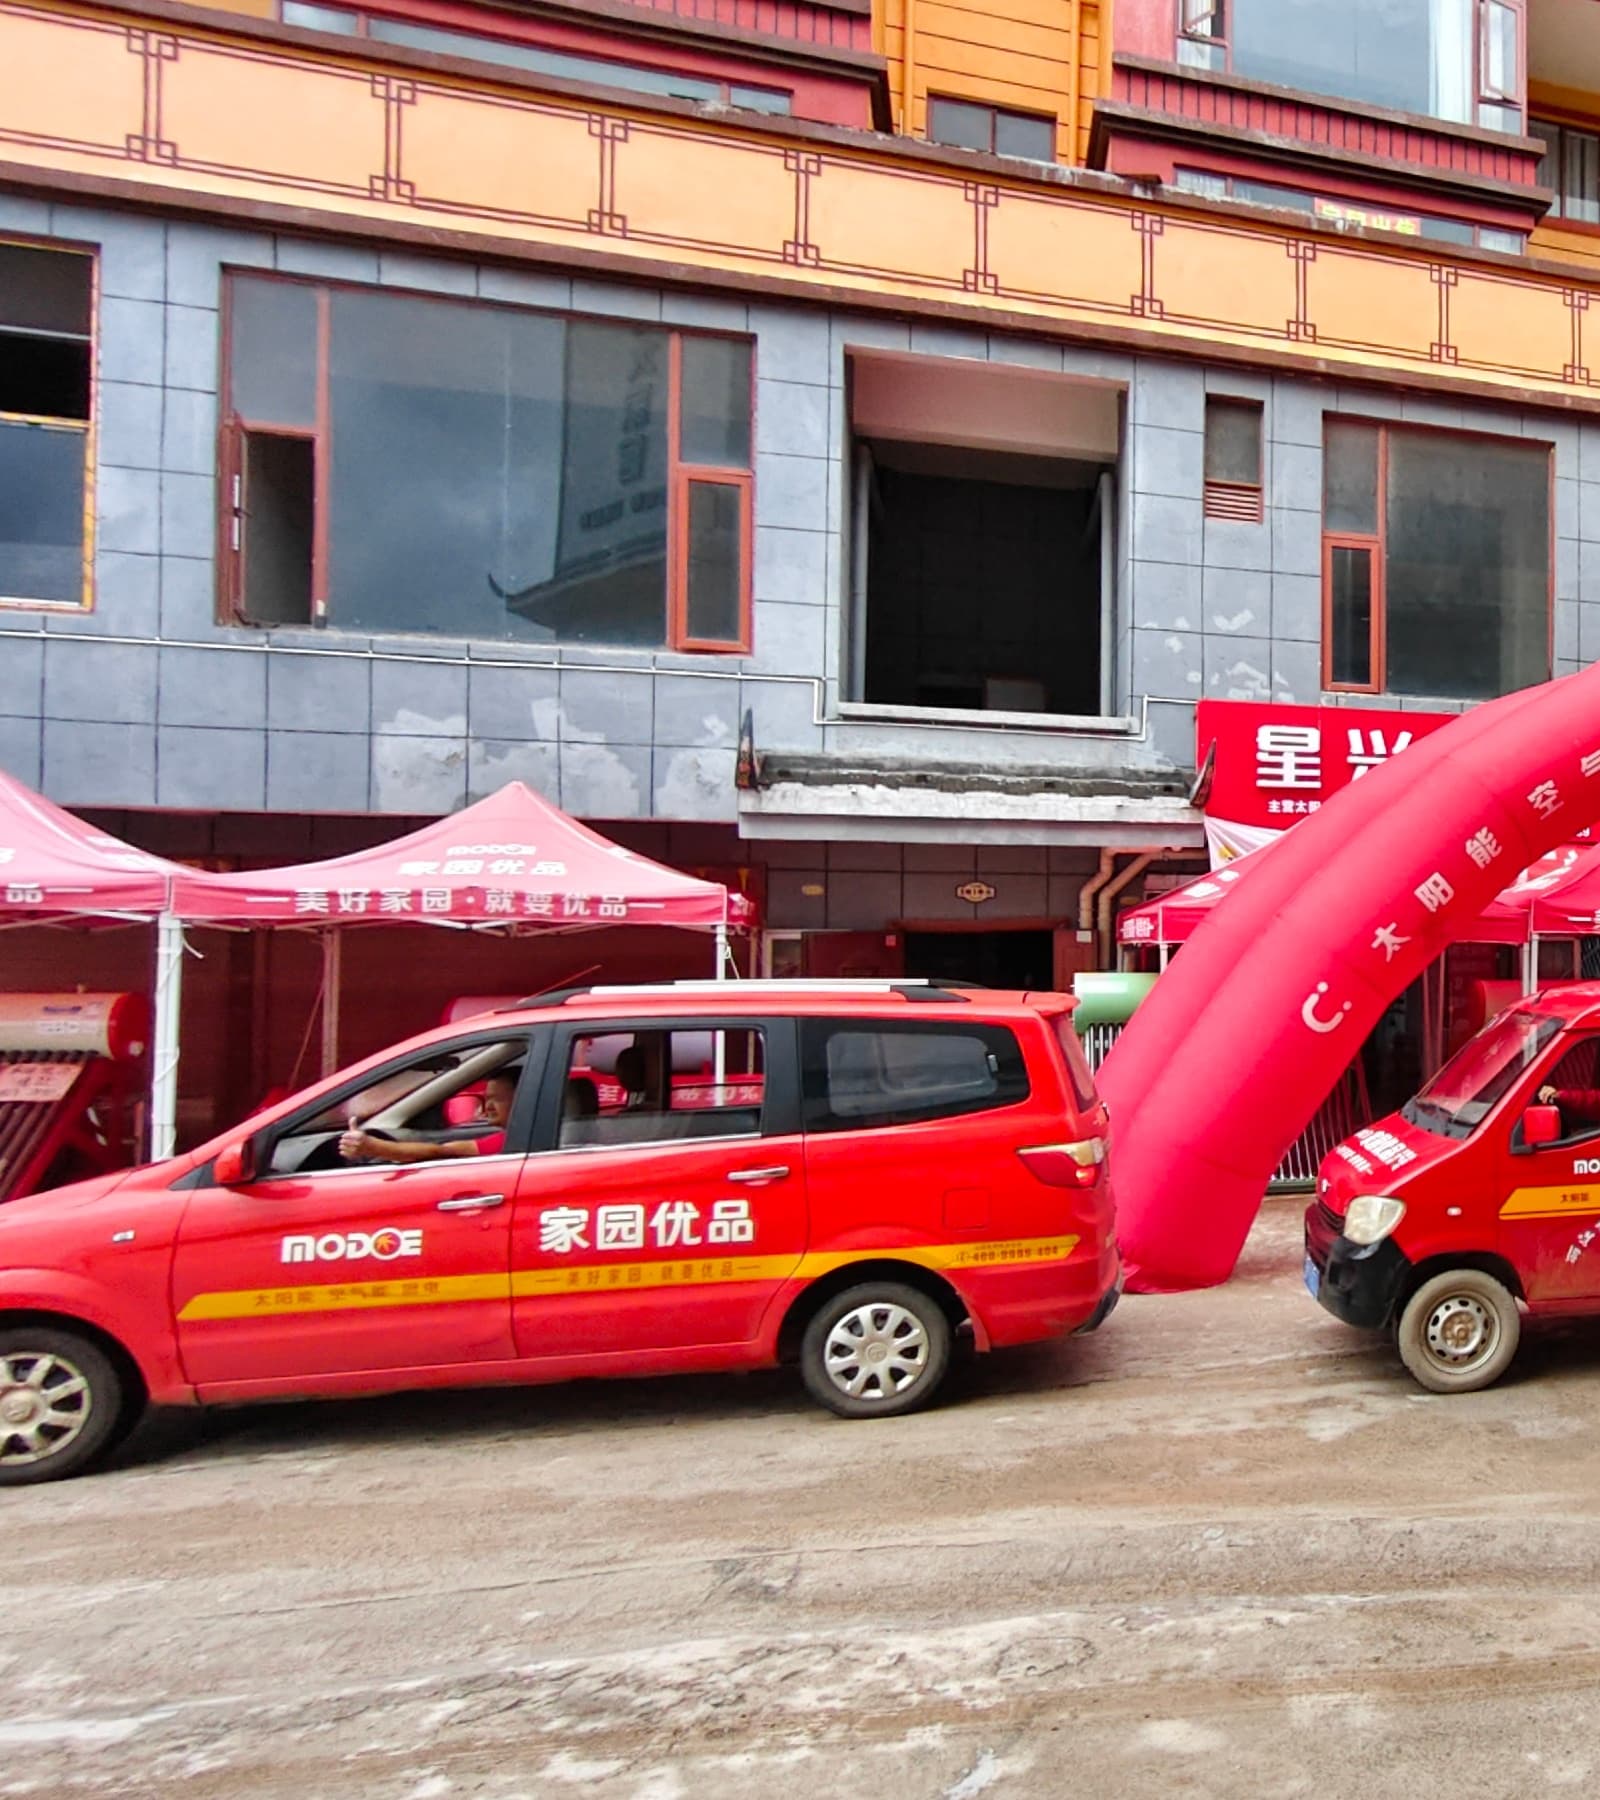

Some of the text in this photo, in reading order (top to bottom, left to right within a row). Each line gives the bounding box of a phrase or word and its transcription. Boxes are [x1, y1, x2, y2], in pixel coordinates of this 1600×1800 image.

[295, 887, 628, 917] 美好家园·就要优品
[1371, 825, 1502, 963] 太阳能
[539, 1200, 755, 1254] 家园优品
